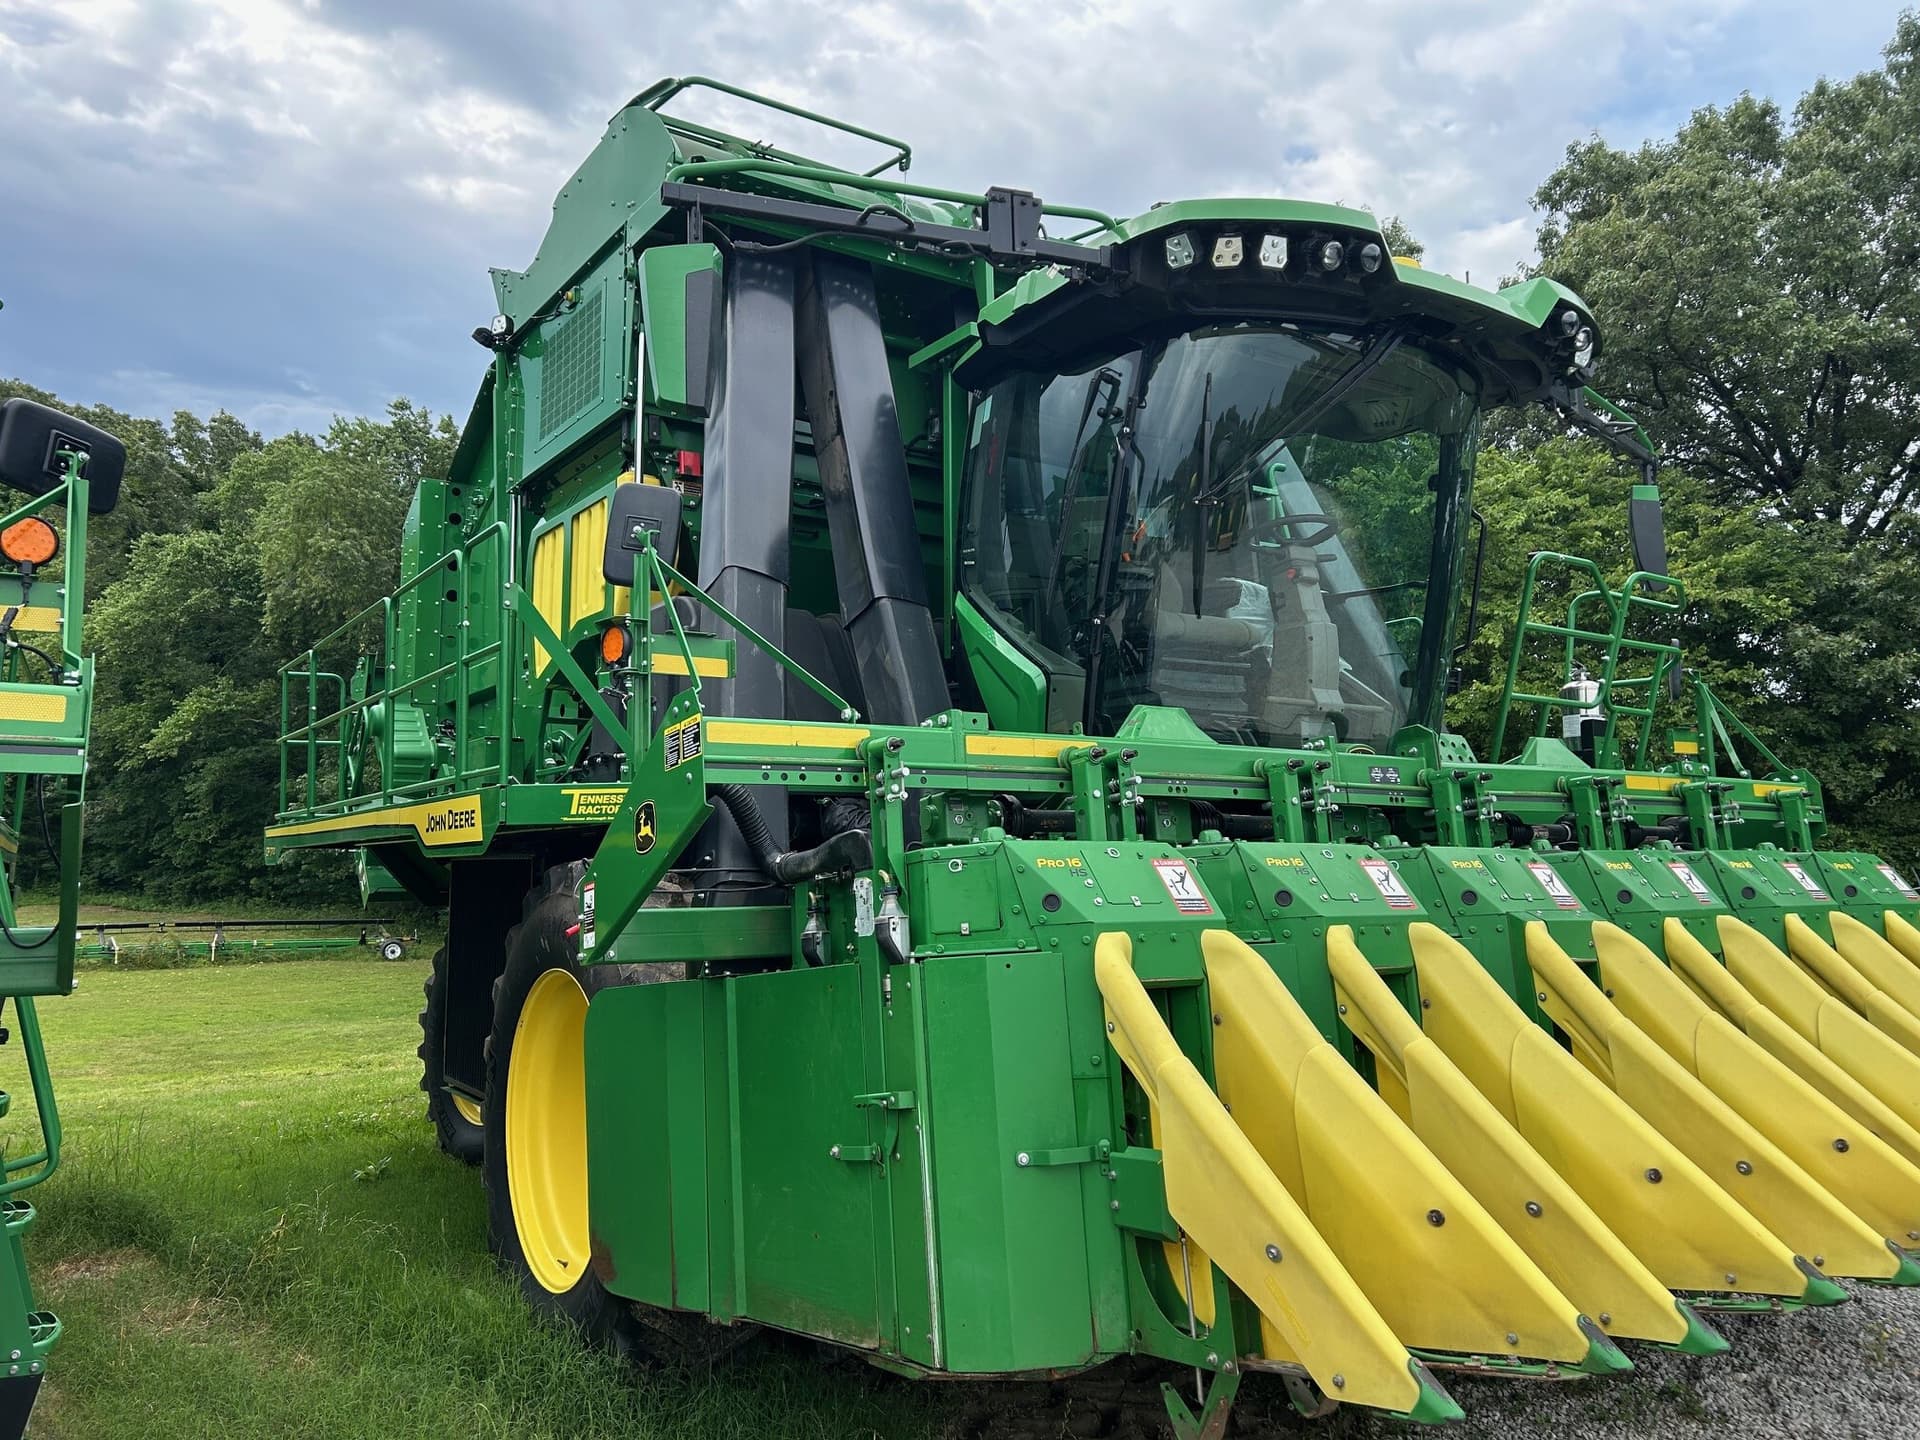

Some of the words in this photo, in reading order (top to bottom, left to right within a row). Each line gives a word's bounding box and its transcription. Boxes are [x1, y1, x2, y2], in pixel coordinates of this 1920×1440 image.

[561, 788, 629, 814] TENNESS
[426, 813, 447, 832] JOHN
[448, 809, 475, 830] DEERE
[1036, 858, 1065, 868] PRO
[1066, 857, 1082, 867] 16
[1290, 857, 1304, 867] 16
[1070, 868, 1088, 877] HS
